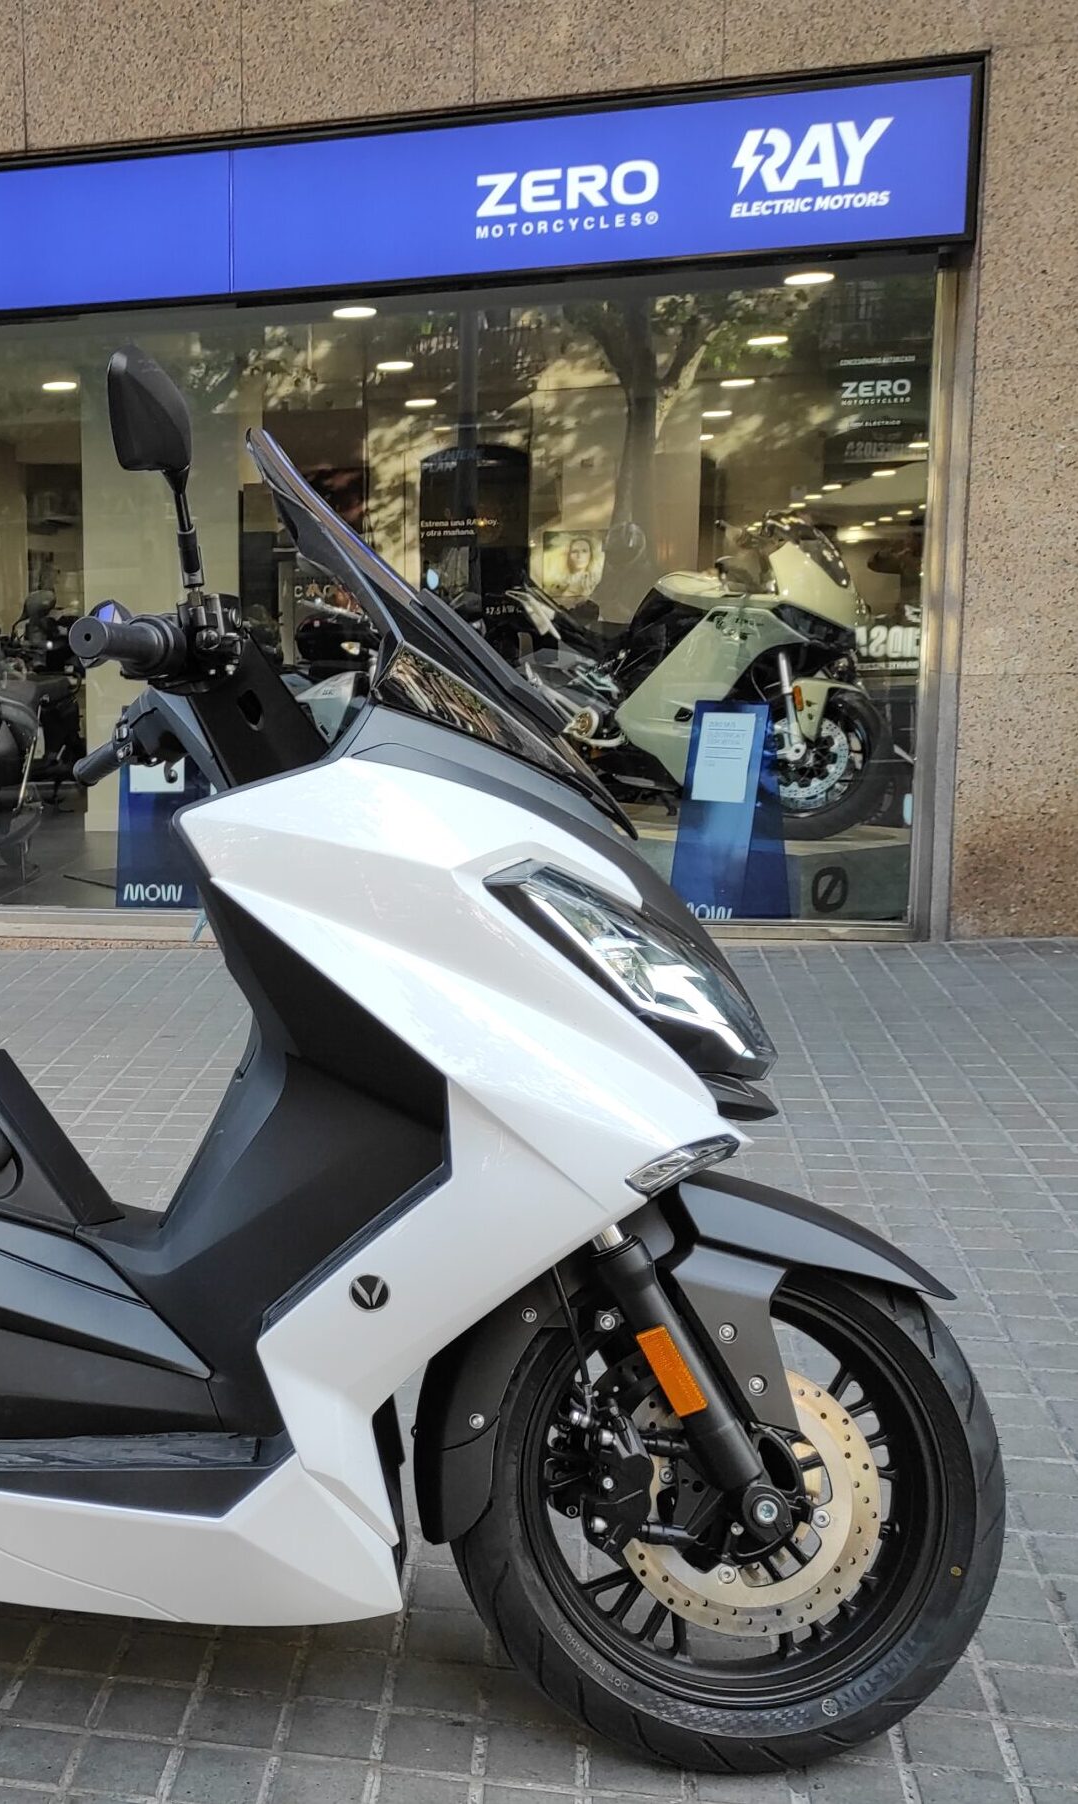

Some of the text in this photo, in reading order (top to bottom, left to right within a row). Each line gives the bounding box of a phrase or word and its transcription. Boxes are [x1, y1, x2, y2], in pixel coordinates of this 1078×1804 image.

[731, 117, 894, 195] RAY
[476, 159, 660, 217] ZERO
[730, 190, 891, 218] ELECTRIC MOTORS
[841, 379, 911, 398] ZERO
[420, 519, 449, 528] Estrena
[450, 519, 465, 528] una
[466, 518, 480, 526] RA
[426, 529, 441, 537] otra
[123, 883, 183, 902] MOW
[608, 1673, 630, 1692] DOT
